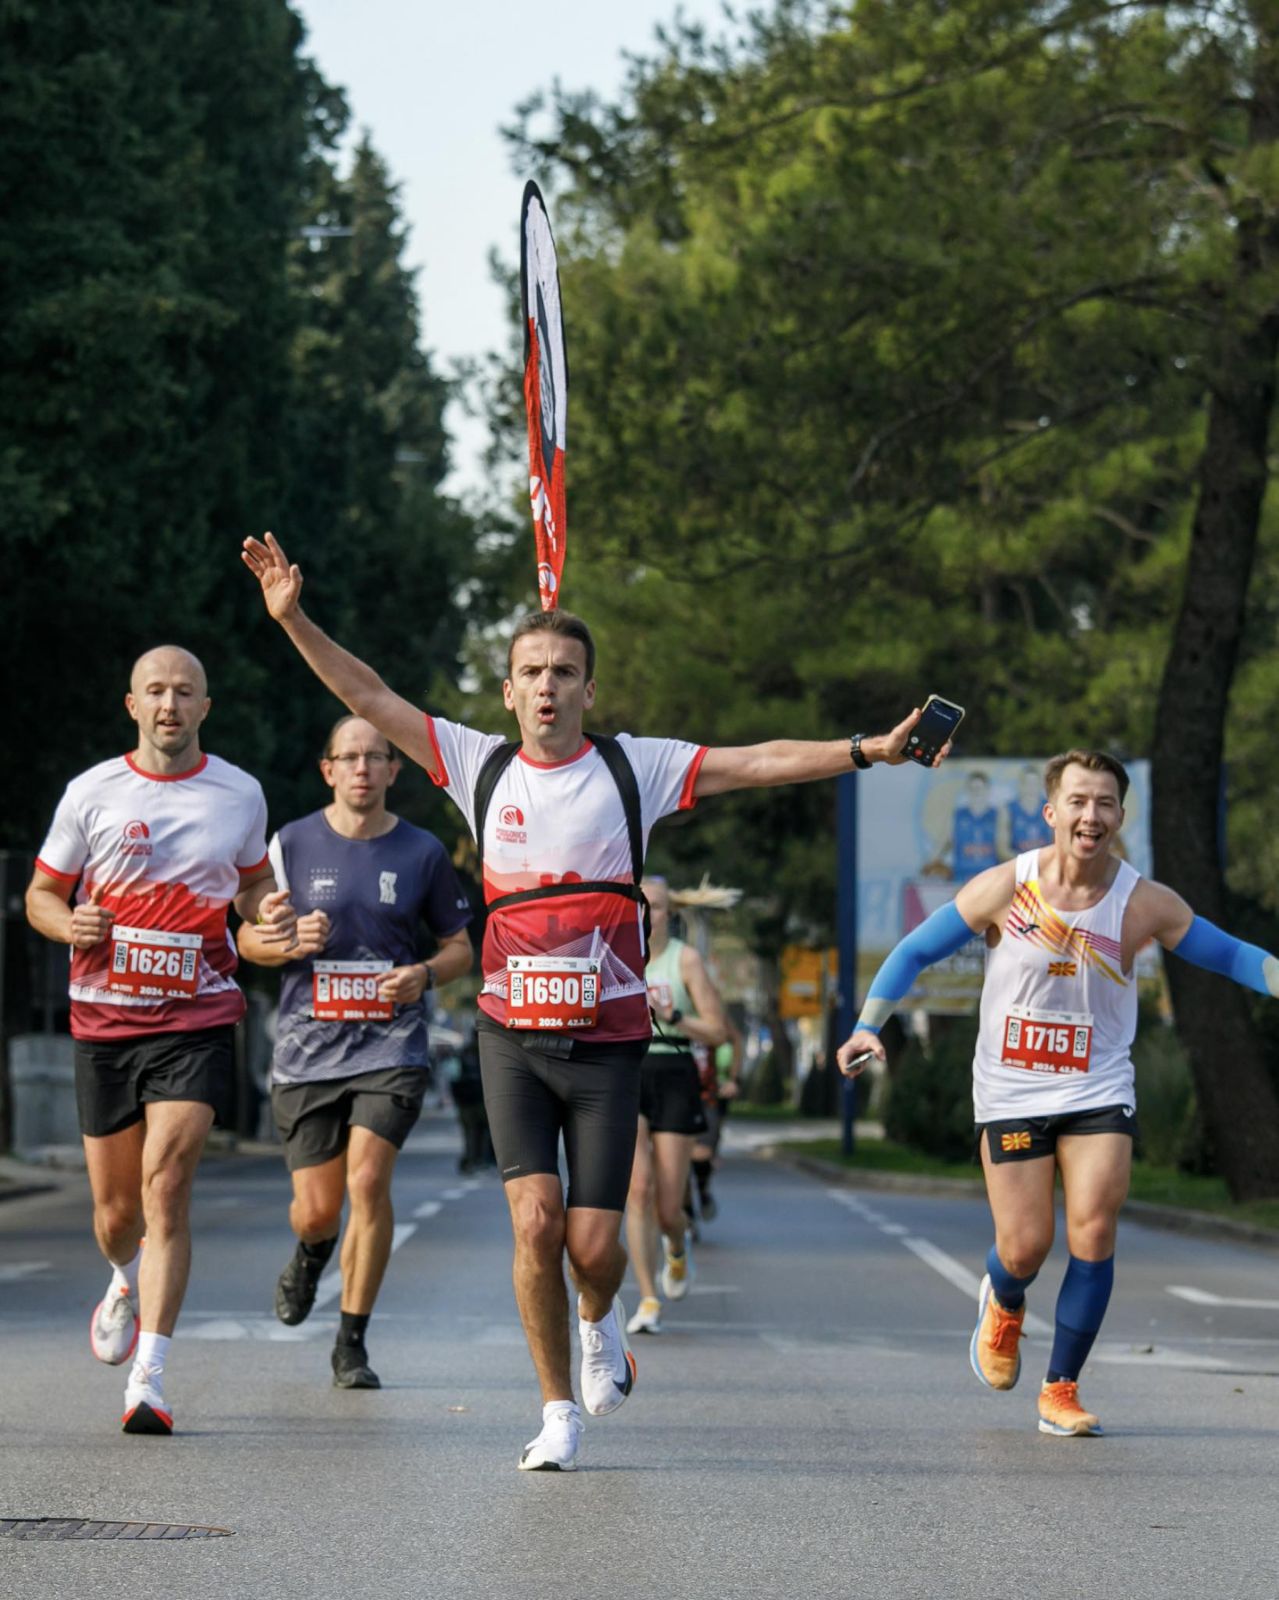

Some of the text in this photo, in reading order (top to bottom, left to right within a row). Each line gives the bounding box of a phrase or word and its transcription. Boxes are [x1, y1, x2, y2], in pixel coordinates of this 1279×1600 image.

[130, 947, 181, 977] 1626
[140, 985, 164, 997] 2024
[330, 977, 376, 1001] 1669
[524, 976, 579, 1005] 1690
[538, 1018, 563, 1027] 2024
[1025, 1025, 1069, 1054] 1715
[1032, 1062, 1056, 1073] 2024
